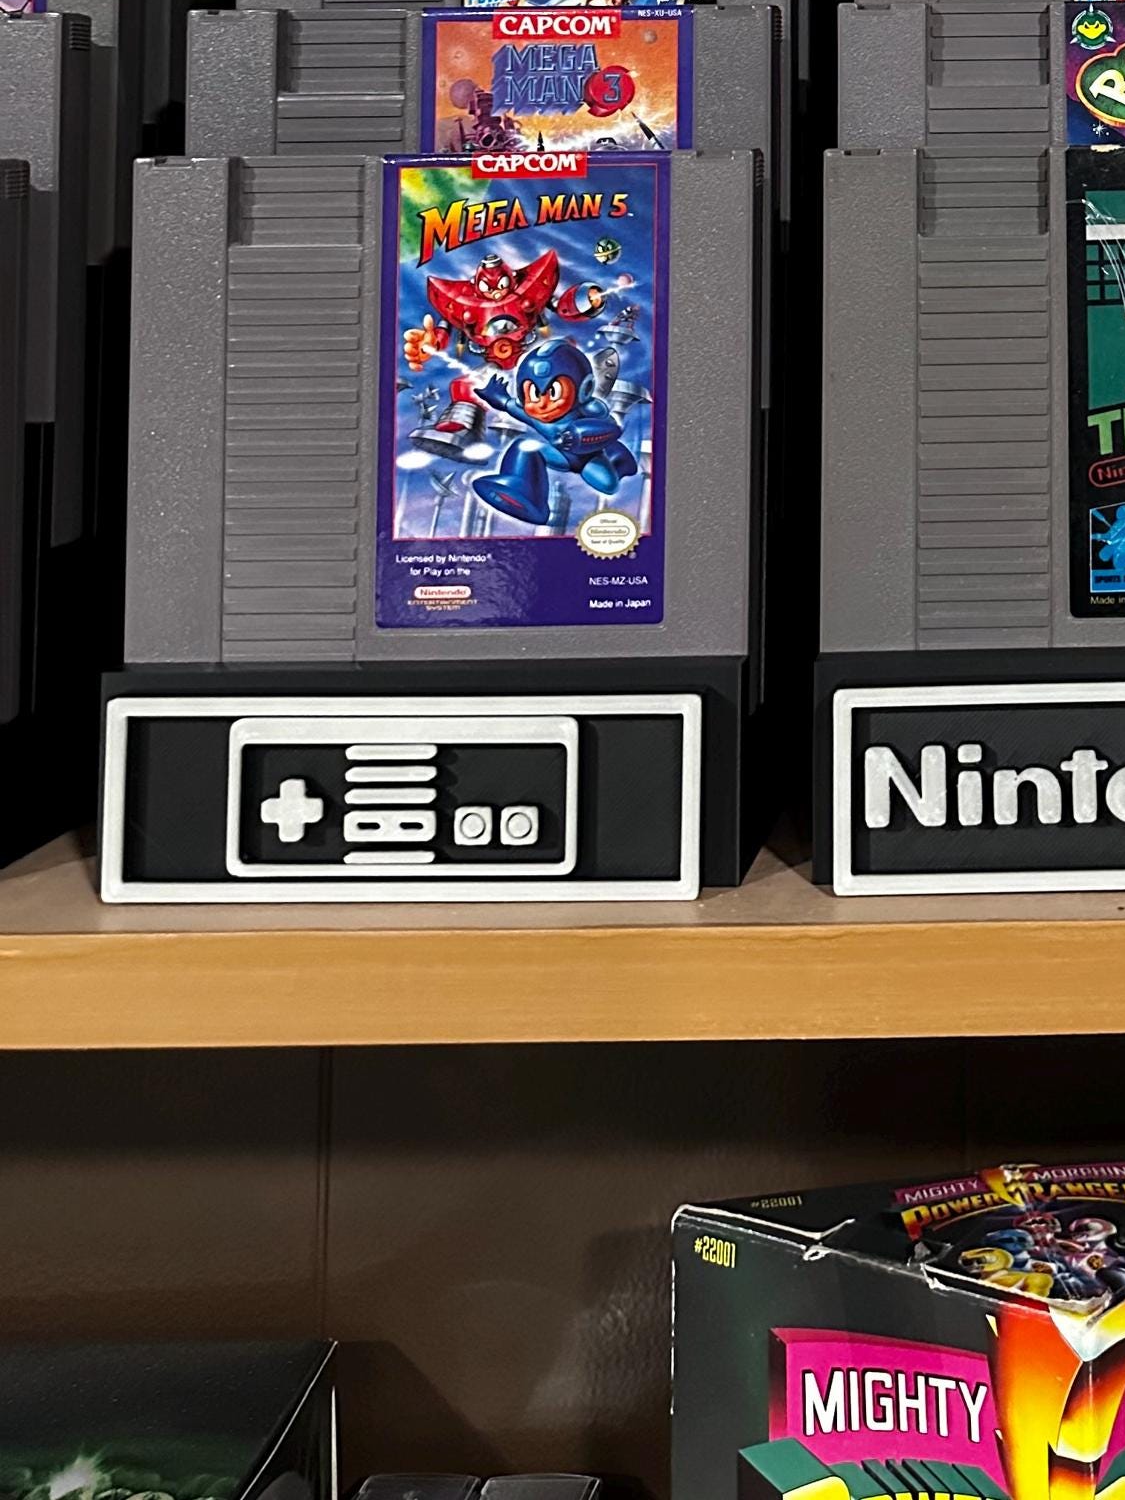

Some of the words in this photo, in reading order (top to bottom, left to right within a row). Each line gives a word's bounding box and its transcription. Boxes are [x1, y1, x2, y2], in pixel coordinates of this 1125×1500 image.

[499, 16, 613, 36] CAPCOM
[502, 43, 600, 73] MEGA
[502, 74, 587, 106] MAN
[603, 73, 622, 102] 3
[476, 154, 578, 172] CAPCOM
[417, 198, 529, 268] MEGA
[537, 193, 603, 226] MAN
[609, 193, 629, 218] 5
[396, 554, 434, 563] Licensed
[436, 555, 446, 565] by
[410, 566, 422, 576] for
[423, 566, 442, 578] Play
[444, 568, 455, 576] on
[457, 566, 471, 576] the
[589, 576, 648, 586] NES-MZ-USA
[589, 599, 613, 609] Made
[614, 599, 623, 608] in
[625, 598, 651, 610] Japan
[1090, 596, 1115, 604] Made
[904, 1179, 979, 1203] MIGHTY
[901, 1191, 1003, 1242] POWER
[694, 1236, 736, 1268] #22001
[804, 1371, 987, 1444] MIGHTY
